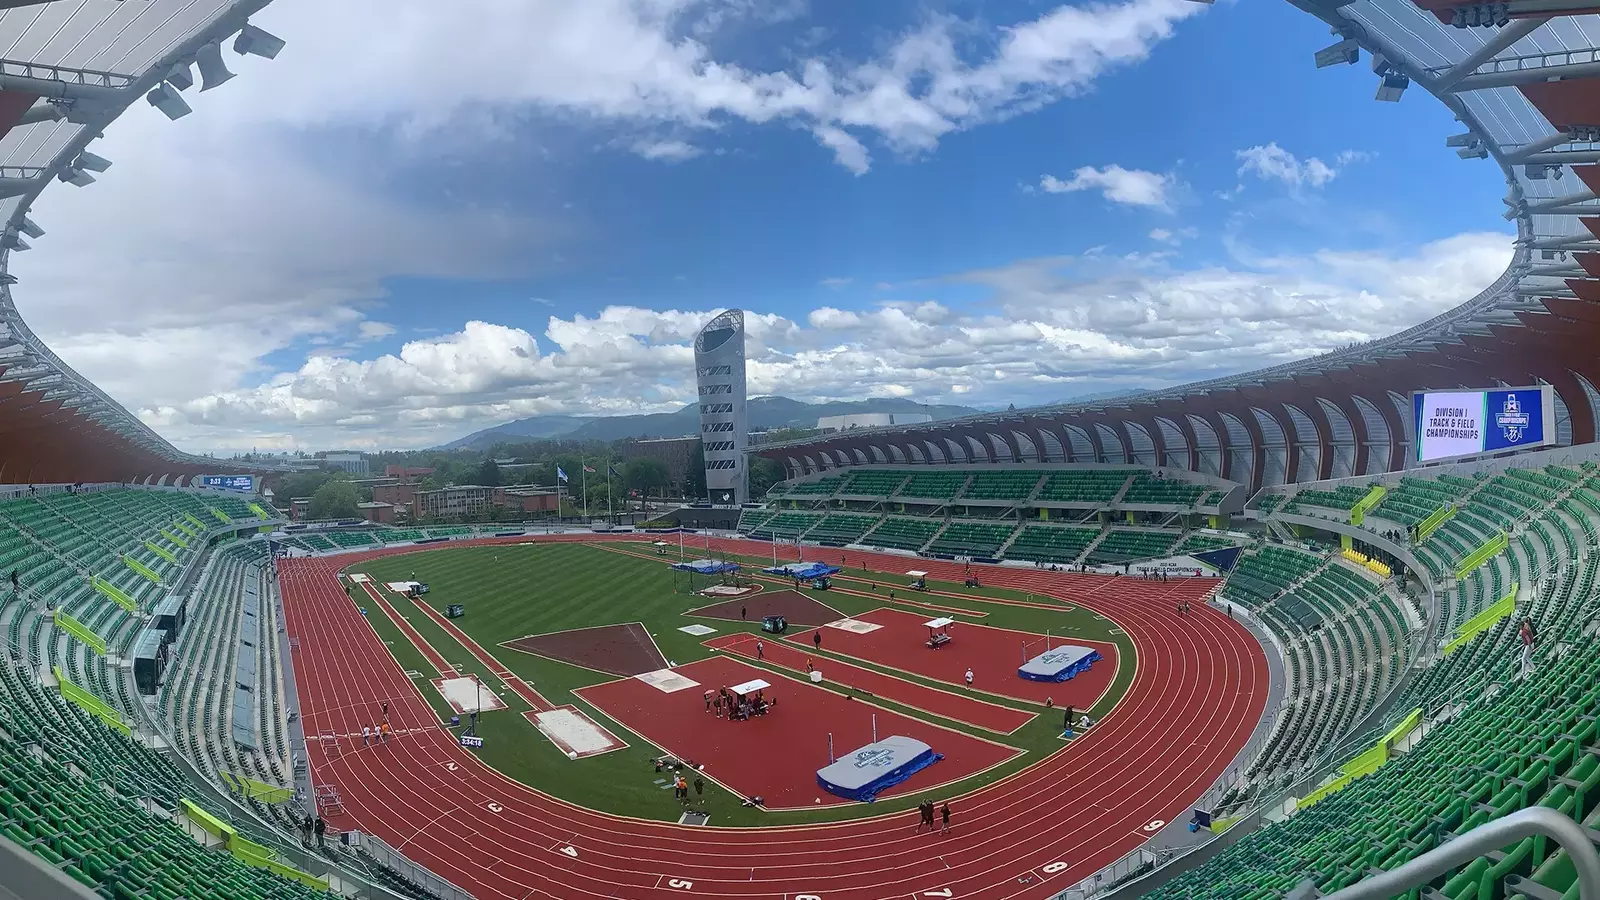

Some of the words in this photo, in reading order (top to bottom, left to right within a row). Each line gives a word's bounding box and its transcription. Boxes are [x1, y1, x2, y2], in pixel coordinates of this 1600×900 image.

[1435, 407, 1463, 417] DIVISION
[1429, 418, 1450, 428] TRACK
[1450, 418, 1456, 428] &
[1457, 419, 1475, 429] FIELD
[1426, 428, 1479, 440] CHAMPIONSHIPS
[446, 762, 458, 771] 2
[487, 802, 503, 813] 3
[1143, 819, 1165, 832] 9
[560, 846, 578, 857] 4
[1042, 861, 1068, 874] 8
[668, 878, 693, 890] 5
[923, 887, 953, 898] 7
